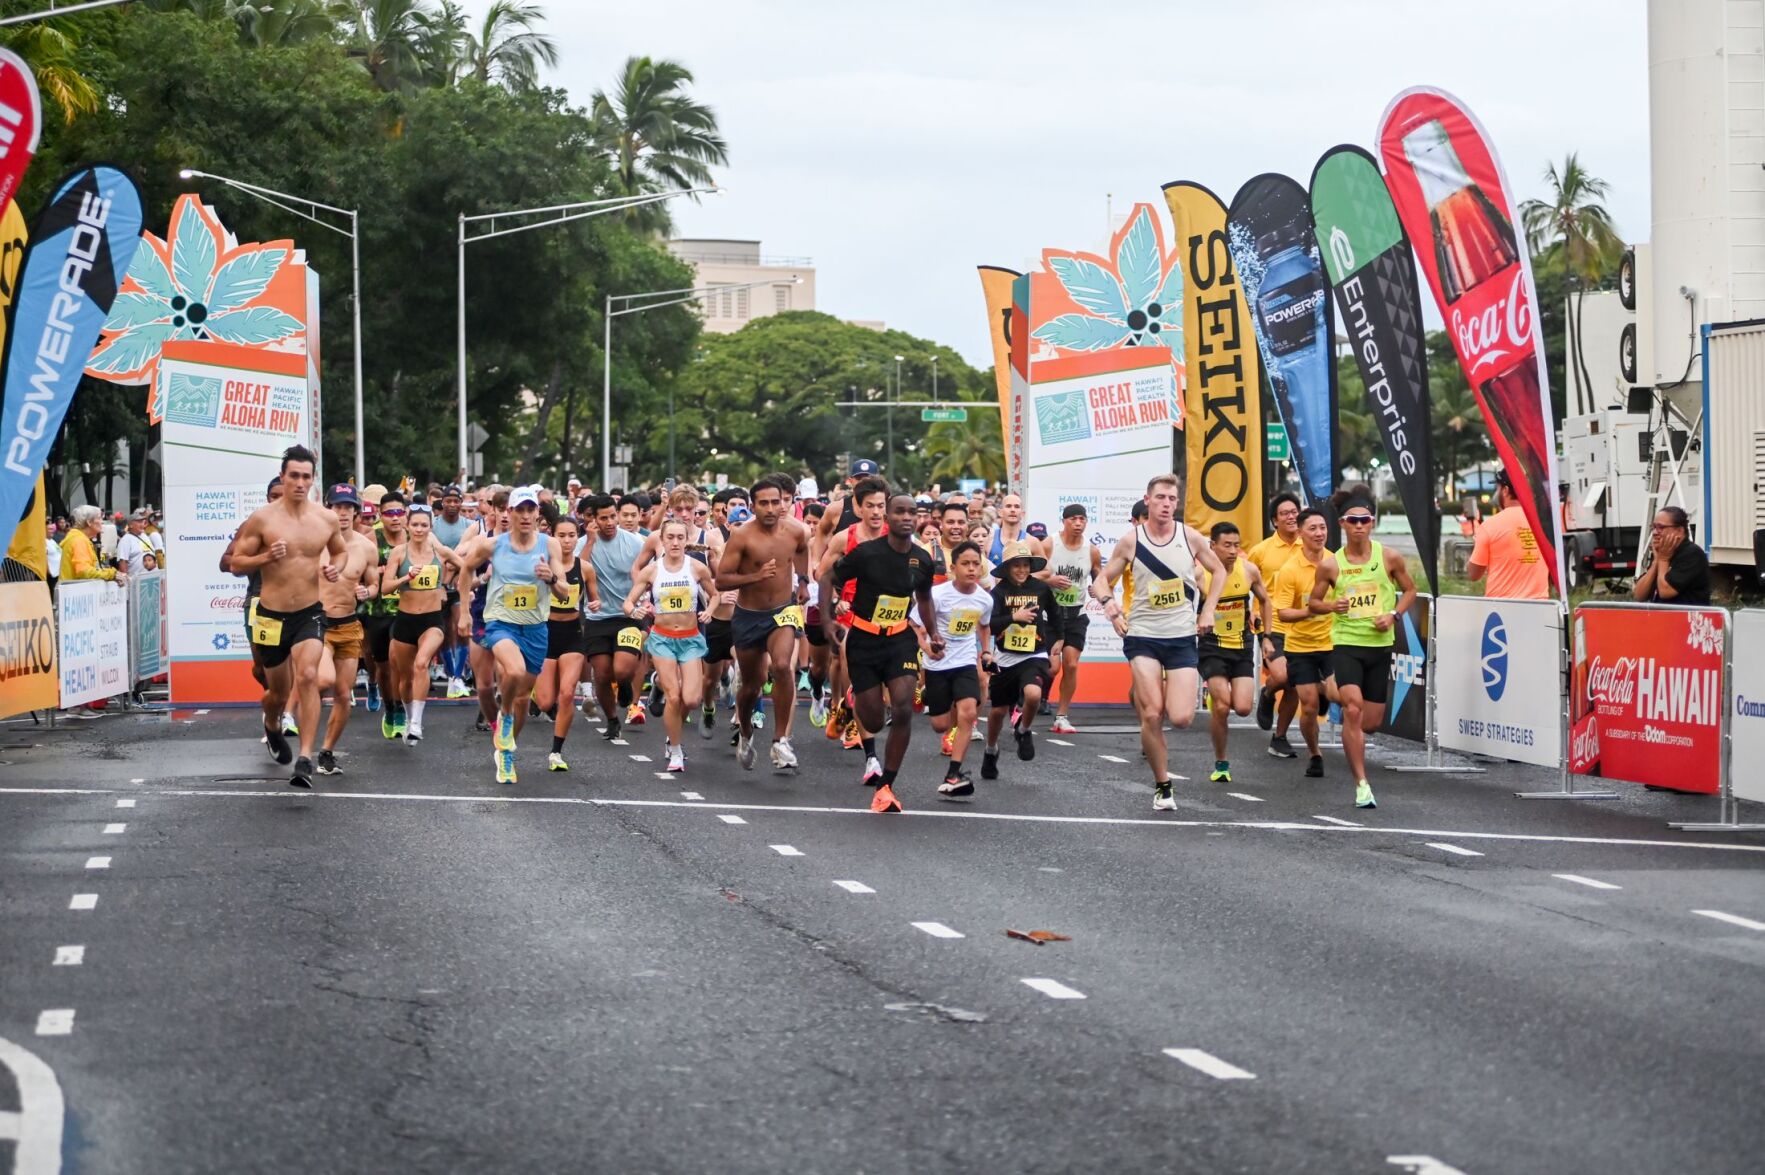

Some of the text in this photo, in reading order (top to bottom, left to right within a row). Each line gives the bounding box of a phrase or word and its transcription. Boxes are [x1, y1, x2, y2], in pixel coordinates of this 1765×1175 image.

[5, 190, 113, 477] POWERADE
[1188, 230, 1249, 512] SEIKO
[1343, 276, 1416, 477] Enterprise
[224, 380, 271, 406] GREAT
[1089, 382, 1132, 409] GREAT
[272, 401, 301, 410] HEALTH
[221, 403, 266, 429] ALOHA
[269, 409, 300, 433] RUN
[1094, 405, 1137, 431] ALOHA
[1139, 399, 1168, 423] RUN
[196, 502, 236, 510] PACIFIC
[196, 512, 236, 520] HEALTH
[418, 576, 430, 586] 46
[514, 597, 527, 607] 13
[670, 598, 682, 608] 50
[1154, 591, 1181, 606] 2561
[1350, 594, 1376, 608] 2447
[878, 608, 904, 621] 2824
[955, 621, 974, 632] 958
[1226, 621, 1233, 631] 9
[259, 630, 267, 641] 6
[1011, 636, 1028, 648] 512
[64, 630, 95, 659] PACIFIC
[65, 665, 96, 696] HEALTH
[1637, 657, 1718, 726] HAWAII
[1459, 718, 1534, 746] SWEEP STRATEGIES
